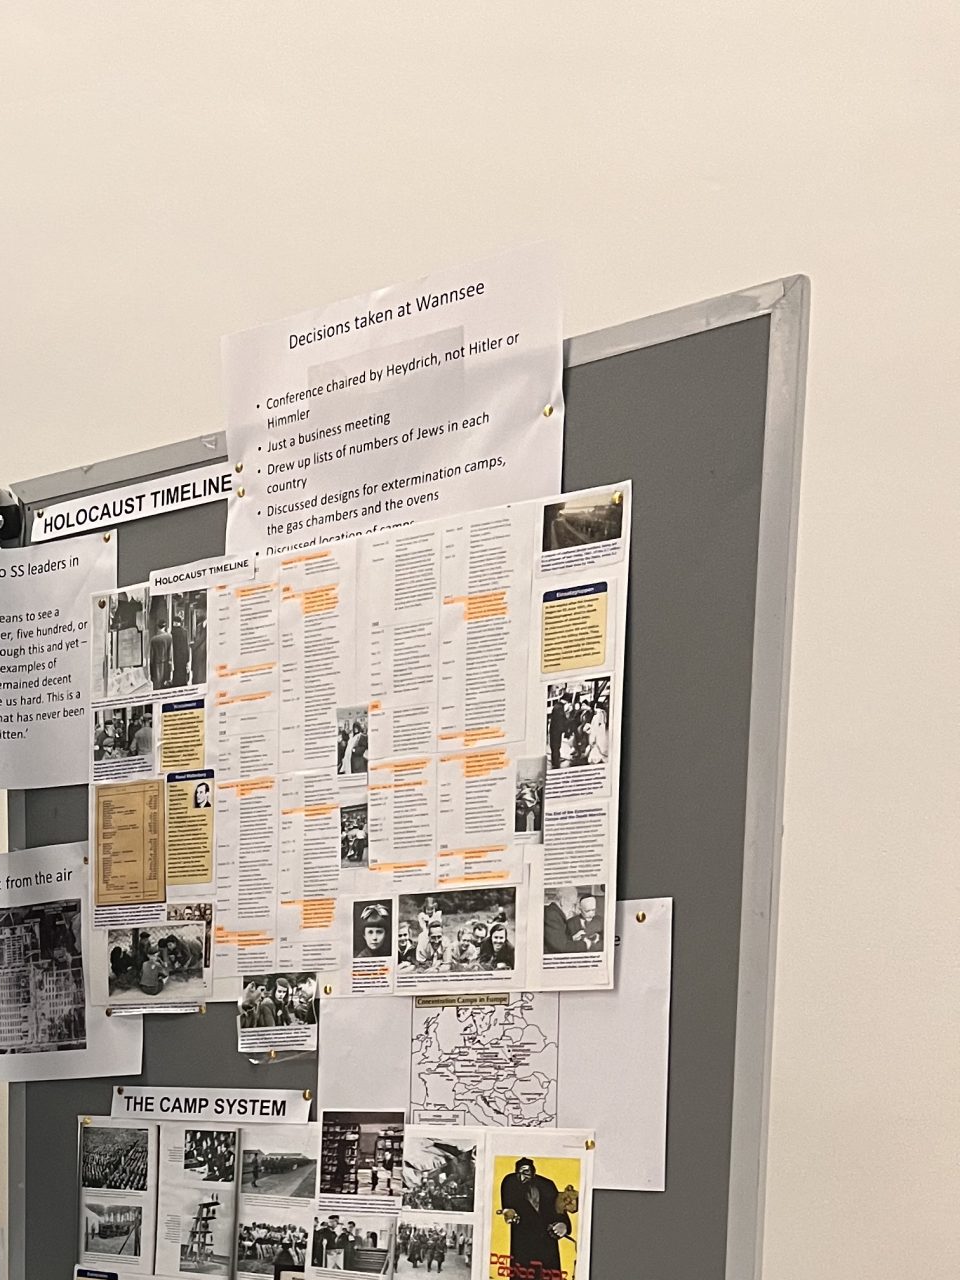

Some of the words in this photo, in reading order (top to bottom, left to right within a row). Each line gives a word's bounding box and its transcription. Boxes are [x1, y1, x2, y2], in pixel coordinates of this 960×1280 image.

[289, 320, 350, 349] Decisions
[354, 309, 392, 329] taken
[397, 301, 411, 317] at
[415, 282, 484, 311] Wannsee
[266, 385, 323, 409] Conference
[326, 370, 365, 393] chaired
[369, 368, 383, 382] by
[386, 352, 441, 377] Heydrich,
[444, 345, 465, 362] not
[469, 337, 503, 355] Hitler
[506, 333, 519, 345] or
[267, 409, 310, 429] Himmler
[267, 438, 287, 452] Just
[289, 437, 295, 447] a
[298, 425, 342, 444] business
[344, 412, 390, 432] meeting
[267, 461, 294, 475] Drew
[297, 457, 310, 469] up
[313, 451, 333, 464] lists
[335, 444, 346, 458] of
[349, 435, 398, 455] numbers
[401, 428, 414, 443] of
[416, 424, 444, 440] Jews
[447, 420, 458, 432] in
[462, 411, 489, 429] each
[266, 477, 307, 494] country
[43, 494, 146, 534] HOLOCAUST
[150, 473, 233, 509] TIMELINE
[10, 564, 25, 578] SS
[27, 559, 66, 575] leaders
[69, 556, 79, 567] in
[154, 568, 207, 586] HOLOCAUST
[208, 559, 248, 574] TIMELINE
[25, 612, 35, 621] to
[37, 610, 52, 620] see
[54, 608, 59, 617] a
[5, 875, 33, 890] from
[34, 871, 53, 885] the
[56, 868, 73, 882] air
[123, 1095, 155, 1112] THE
[159, 1096, 209, 1114] CAMP
[213, 1098, 287, 1117] SYSTEM
